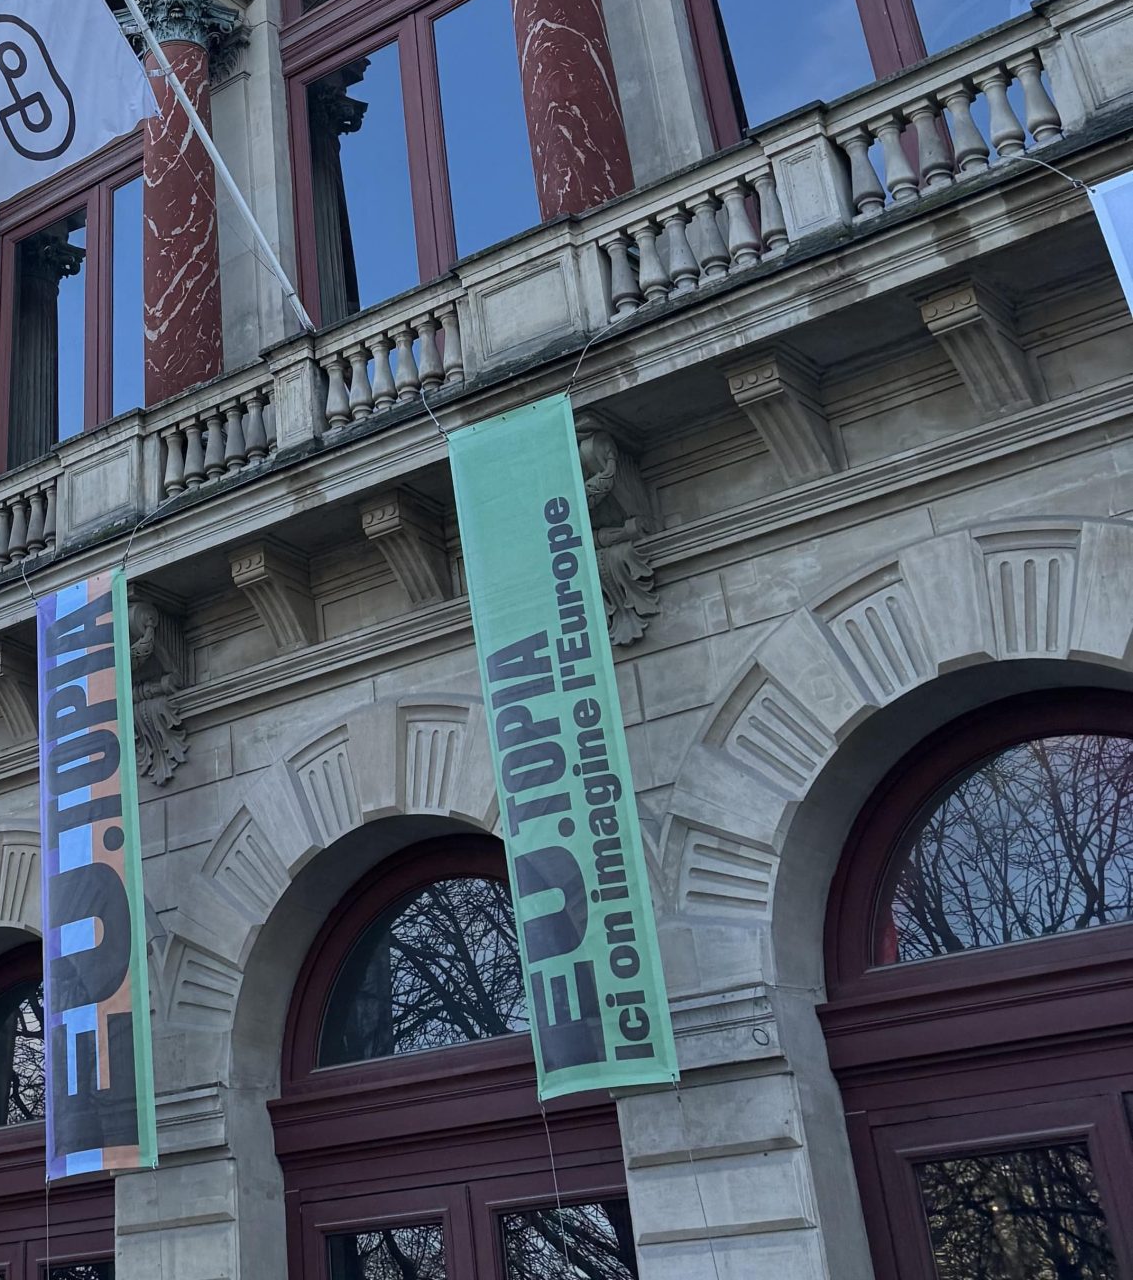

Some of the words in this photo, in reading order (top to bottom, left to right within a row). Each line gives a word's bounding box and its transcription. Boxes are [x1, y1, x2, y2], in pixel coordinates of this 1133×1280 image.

[543, 496, 597, 693] l'Europe
[45, 590, 140, 1159] EU.TOPIA
[485, 629, 608, 1074] EU.TOPIA
[572, 697, 630, 903] imagine
[603, 910, 641, 980] on
[605, 989, 655, 1062] Ici
